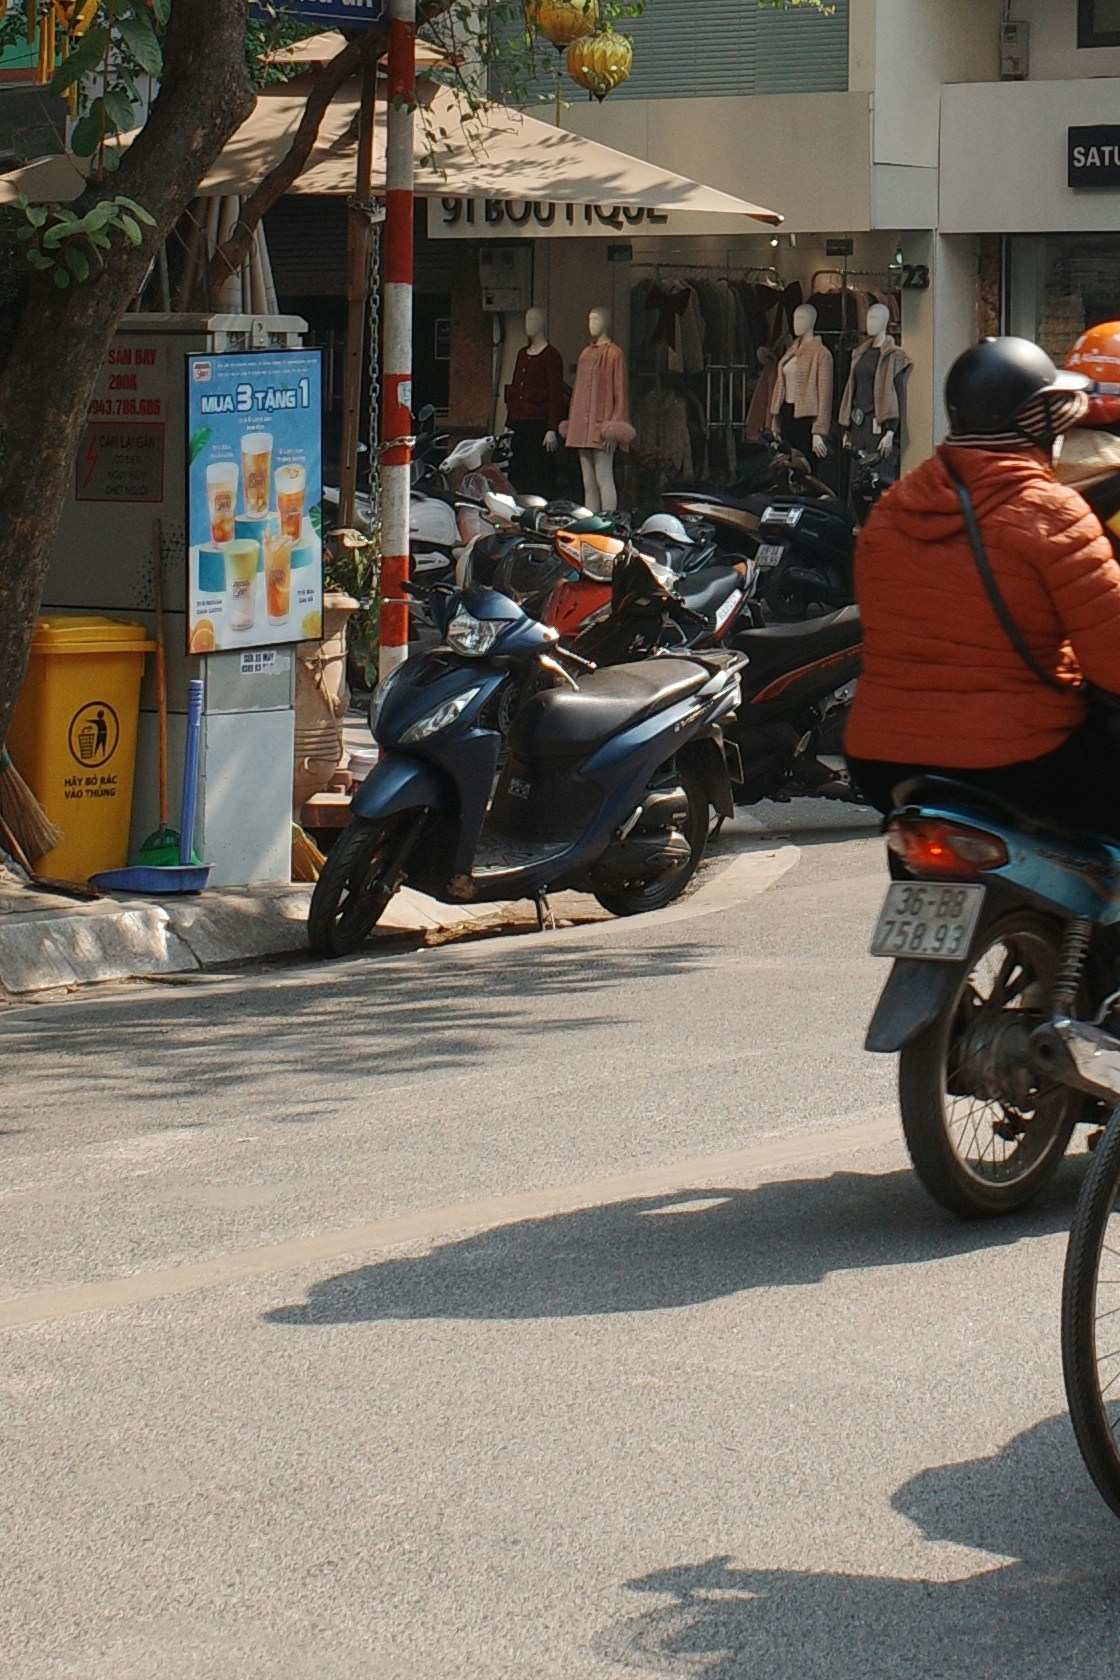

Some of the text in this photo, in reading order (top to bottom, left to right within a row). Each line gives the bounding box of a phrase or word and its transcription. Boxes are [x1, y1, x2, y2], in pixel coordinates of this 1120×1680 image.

[902, 264, 930, 290] 23
[201, 377, 310, 414] MUA 3 TẶNG 1
[64, 773, 118, 787] HÃY BỎ RÁC
[64, 785, 116, 799] VÀO THÙNG
[895, 886, 967, 919] 36-B8
[880, 919, 964, 954] 758.93
